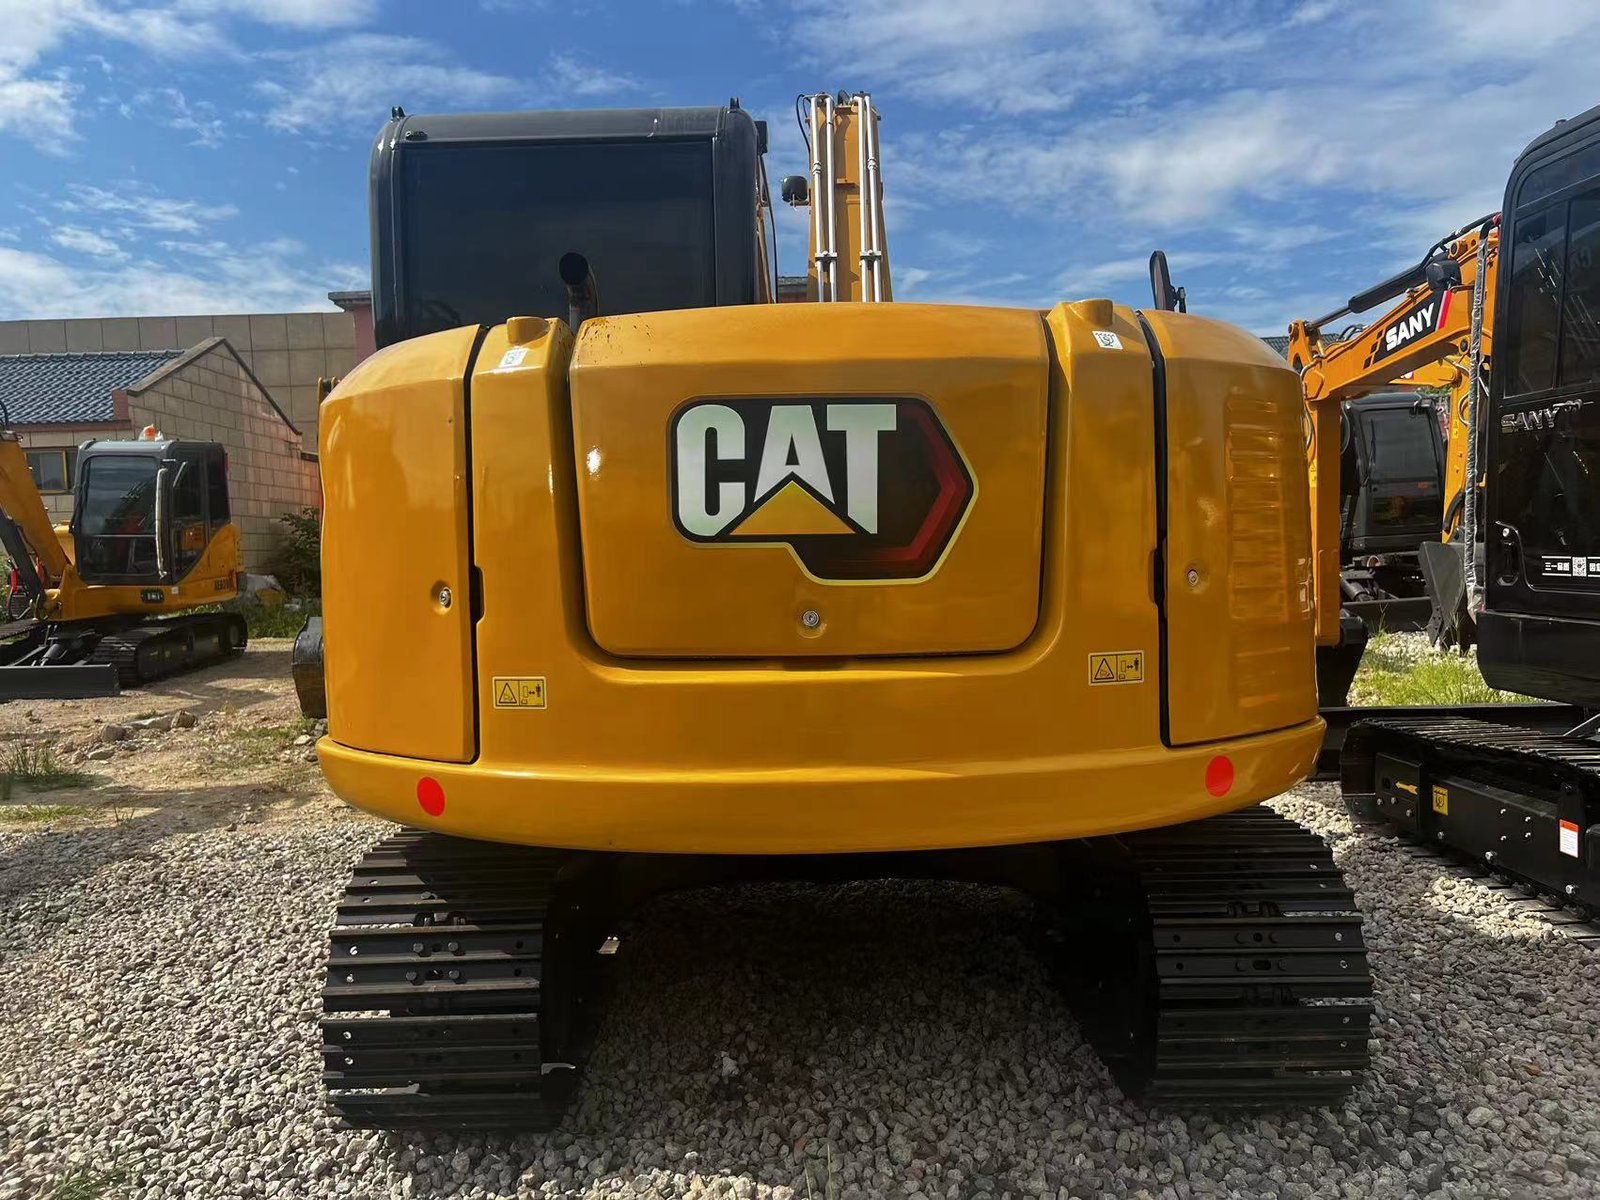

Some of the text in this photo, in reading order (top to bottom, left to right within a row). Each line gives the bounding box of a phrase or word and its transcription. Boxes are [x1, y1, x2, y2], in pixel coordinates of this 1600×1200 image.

[1385, 302, 1434, 351] SANY
[1501, 407, 1560, 433] SANY
[676, 404, 897, 536] CAT
